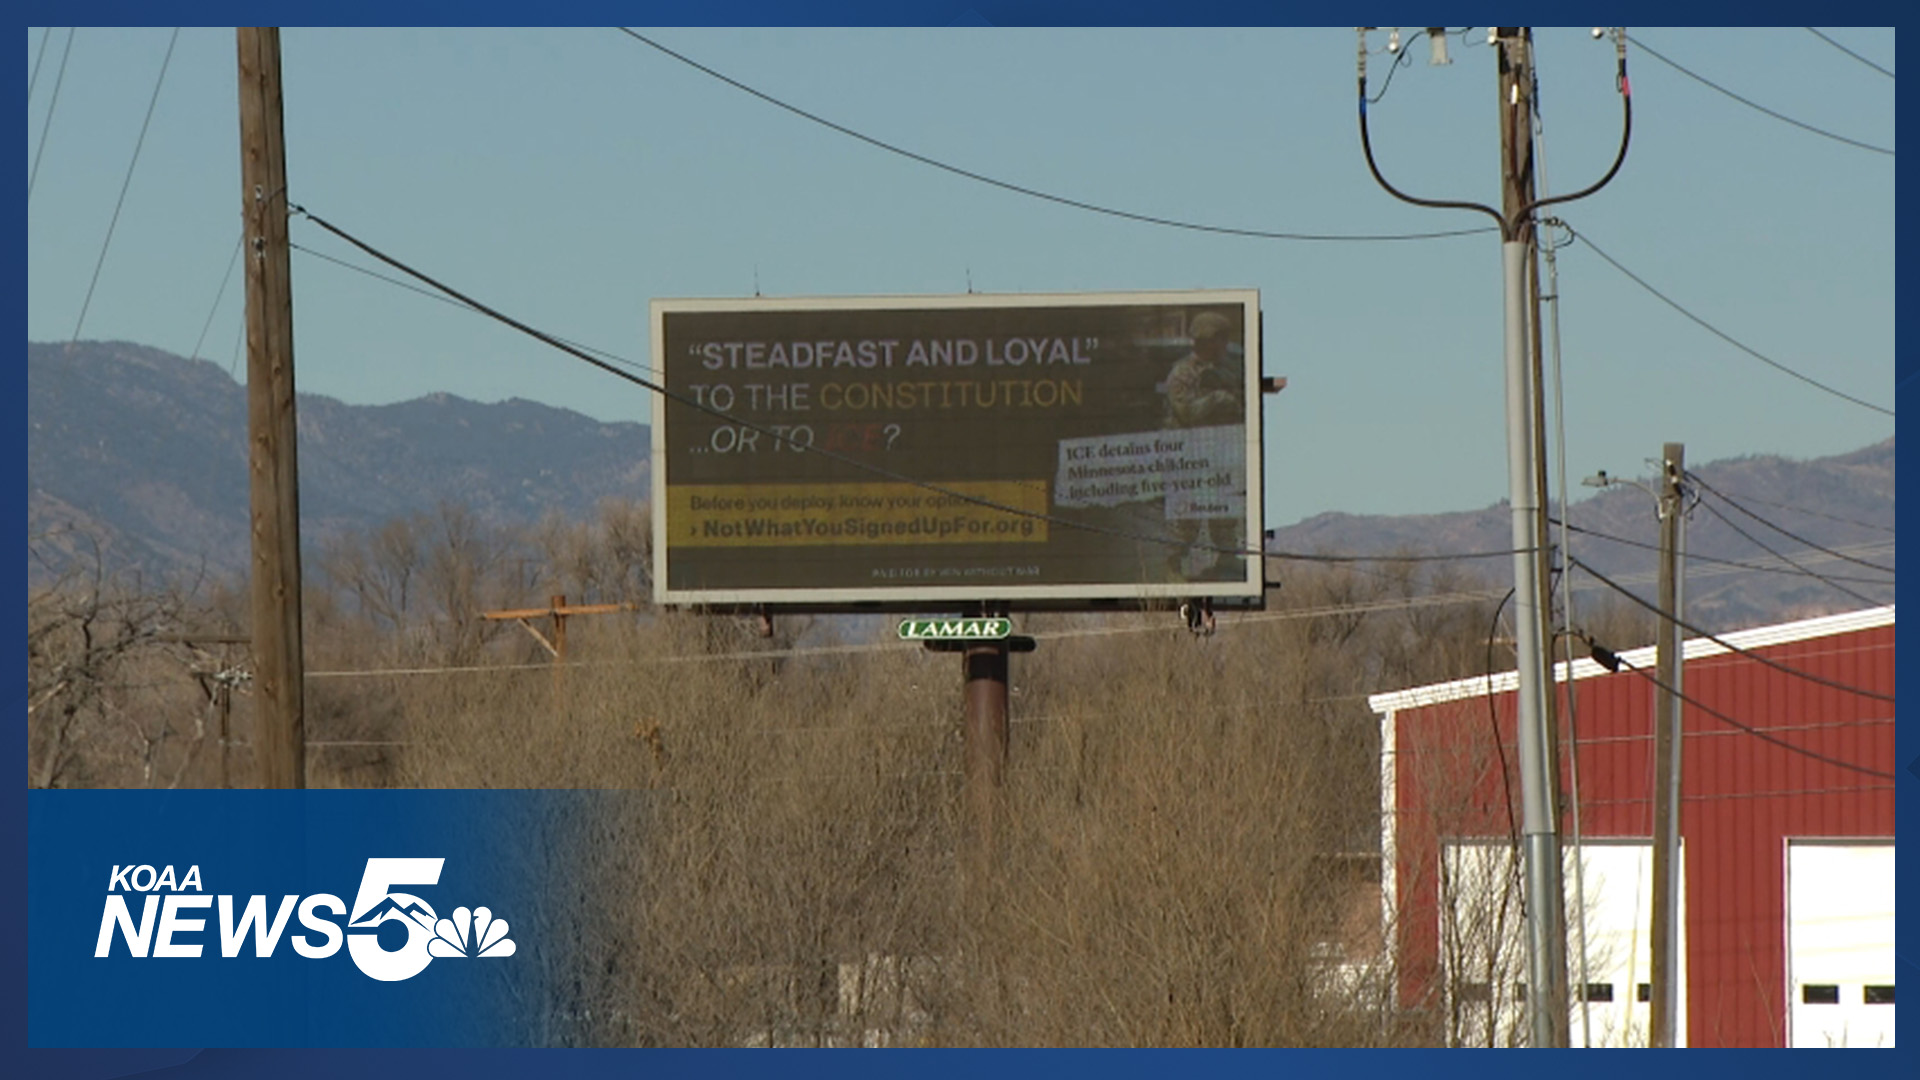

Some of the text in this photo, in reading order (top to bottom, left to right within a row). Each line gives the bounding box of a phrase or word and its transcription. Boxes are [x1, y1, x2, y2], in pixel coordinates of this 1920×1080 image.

[905, 339, 978, 366] AND
[689, 380, 1082, 411] TO THE CONSTITUTION
[771, 425, 814, 452] TO
[1066, 440, 1185, 461] ICE detains four
[1068, 458, 1209, 480] Minnesota children
[1069, 482, 1139, 499] including
[690, 495, 745, 511] Before
[750, 498, 779, 512] you
[840, 495, 884, 508] know
[888, 497, 921, 509] your
[704, 516, 1034, 538] NotWhatYouSignedUpFor.org
[907, 621, 1000, 637] LAMAR
